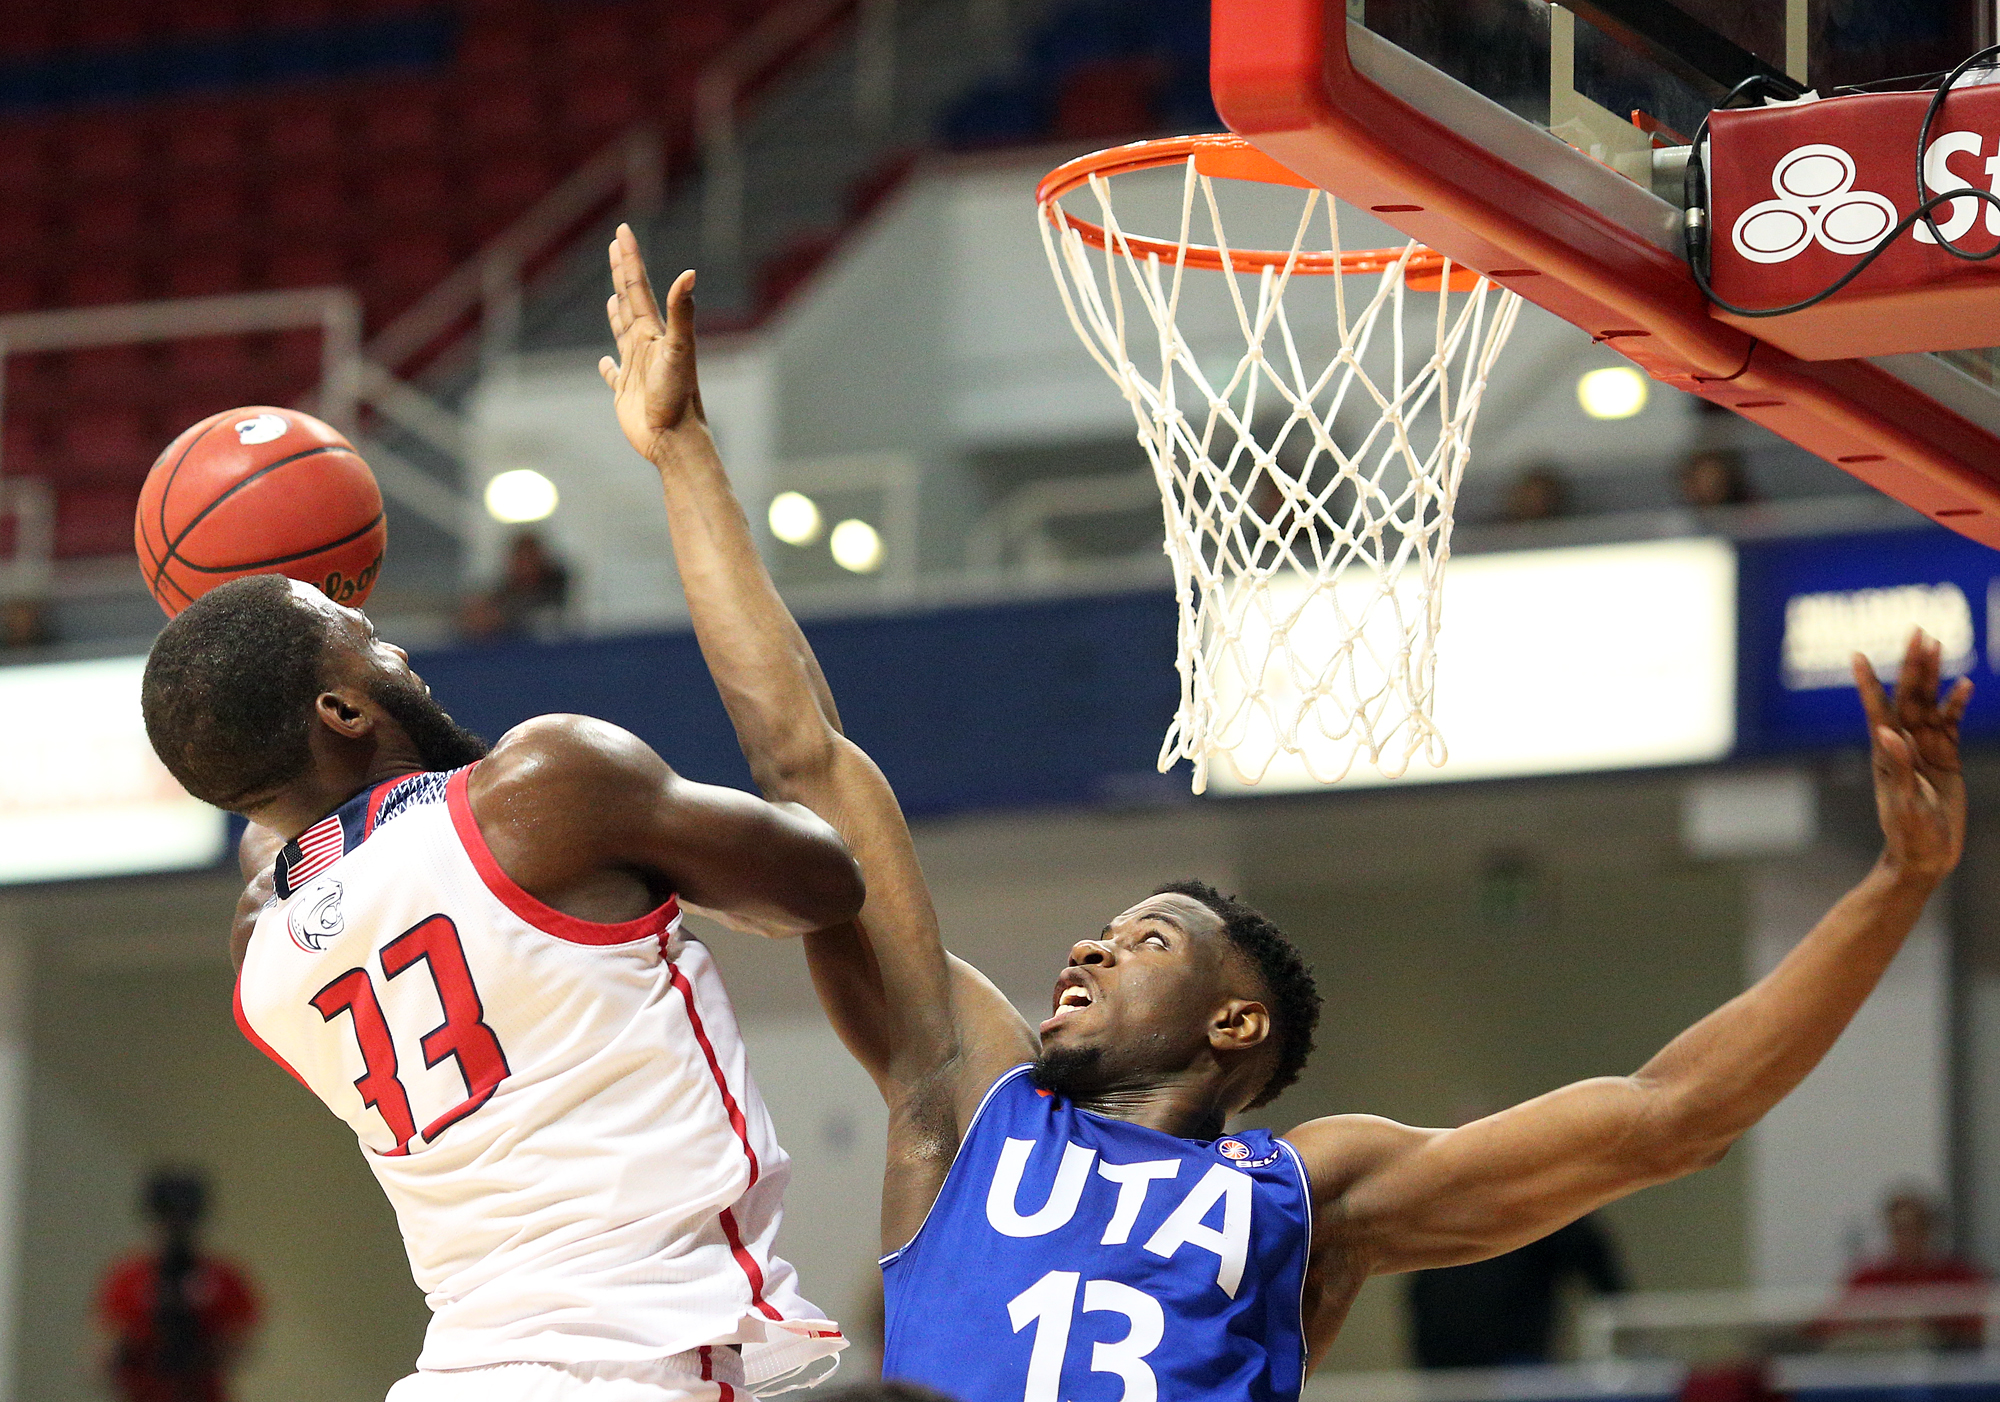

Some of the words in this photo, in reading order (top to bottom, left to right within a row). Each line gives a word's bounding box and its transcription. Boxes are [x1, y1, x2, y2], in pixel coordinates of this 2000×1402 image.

[986, 1136, 1254, 1300] UTA
[1235, 1149, 1279, 1168] BELT
[1006, 1270, 1166, 1402] 13
